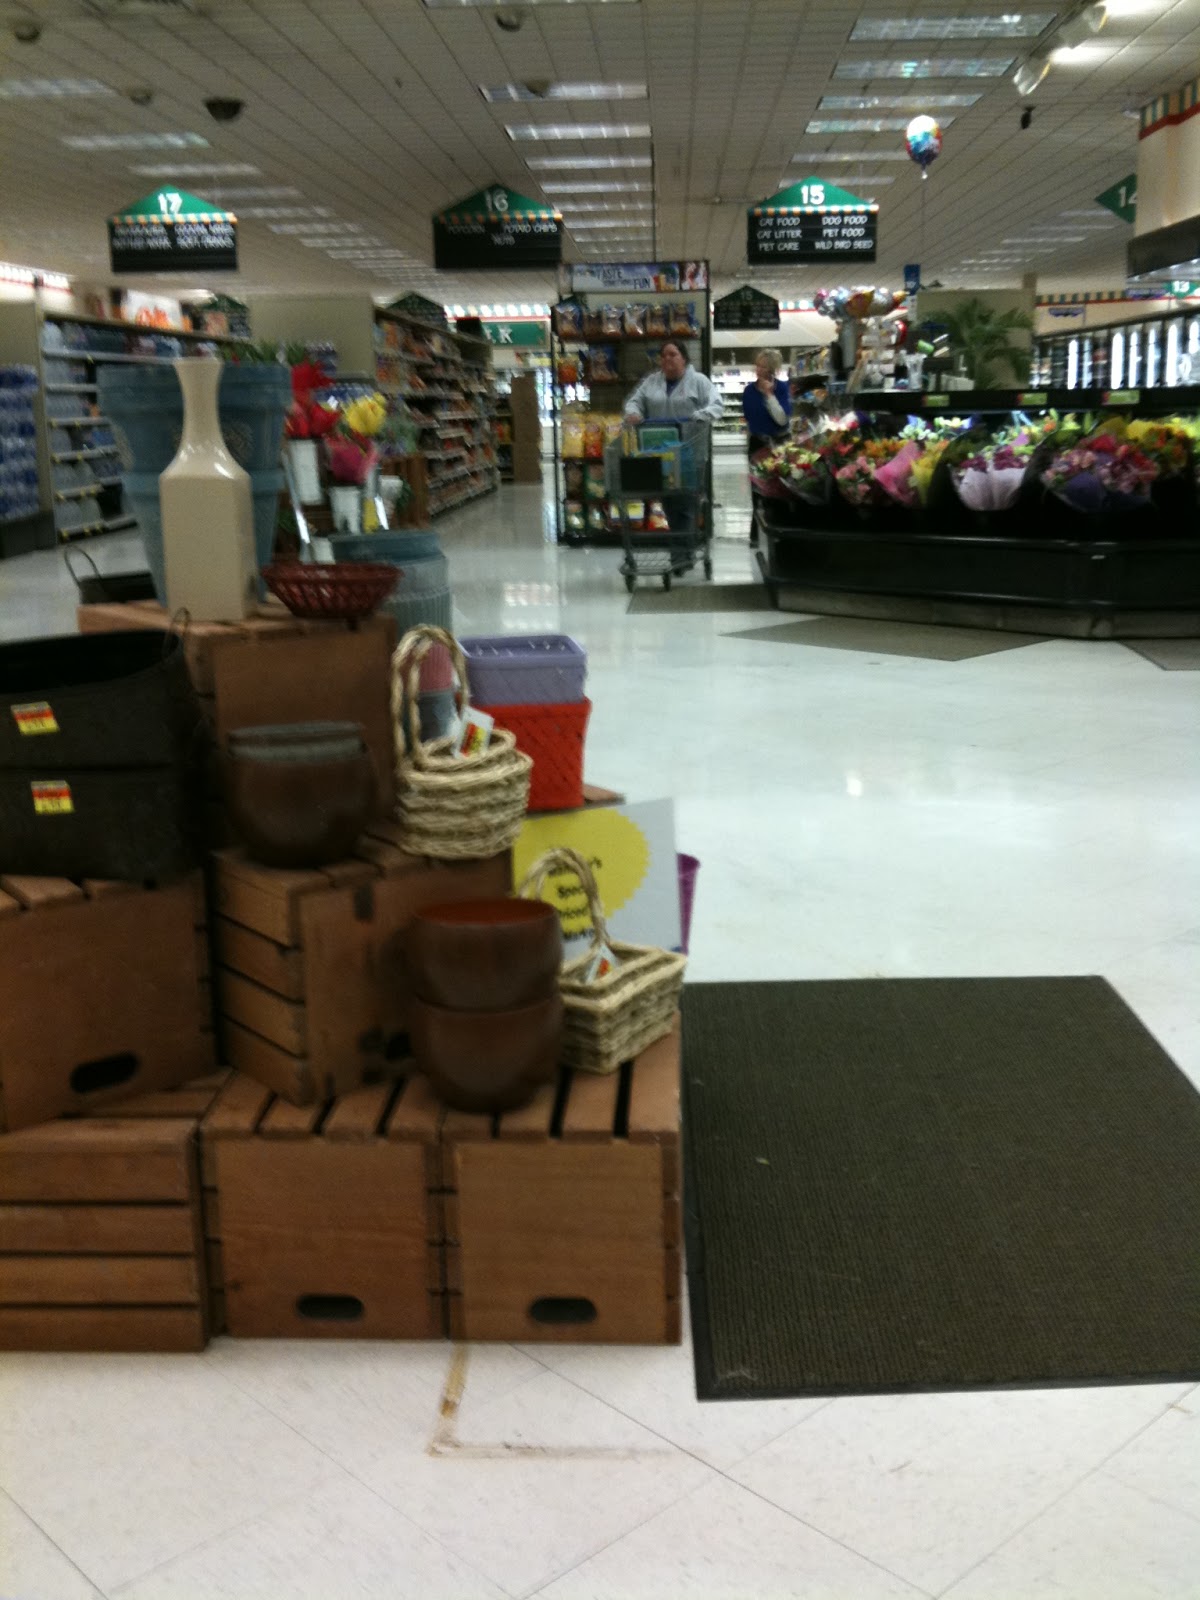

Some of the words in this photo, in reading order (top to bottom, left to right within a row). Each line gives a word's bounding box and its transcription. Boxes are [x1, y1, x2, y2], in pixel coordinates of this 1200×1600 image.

[801, 184, 825, 205] 15
[158, 192, 183, 214] 17
[484, 189, 509, 212] 16
[759, 217, 773, 227] CAT
[777, 217, 800, 226] FOOD
[822, 216, 841, 226] DOG
[844, 215, 868, 225] FOOD
[503, 223, 531, 234] POTATO
[532, 222, 558, 233] CHIPS
[822, 228, 838, 238] PET
[841, 228, 866, 238] FOOD
[757, 230, 771, 239] CAT
[774, 229, 802, 239] LITTER
[758, 242, 774, 252] PET
[777, 241, 799, 251] CARE
[814, 240, 833, 250] WILD
[834, 240, 851, 249] BIRD
[853, 240, 873, 249] SEED
